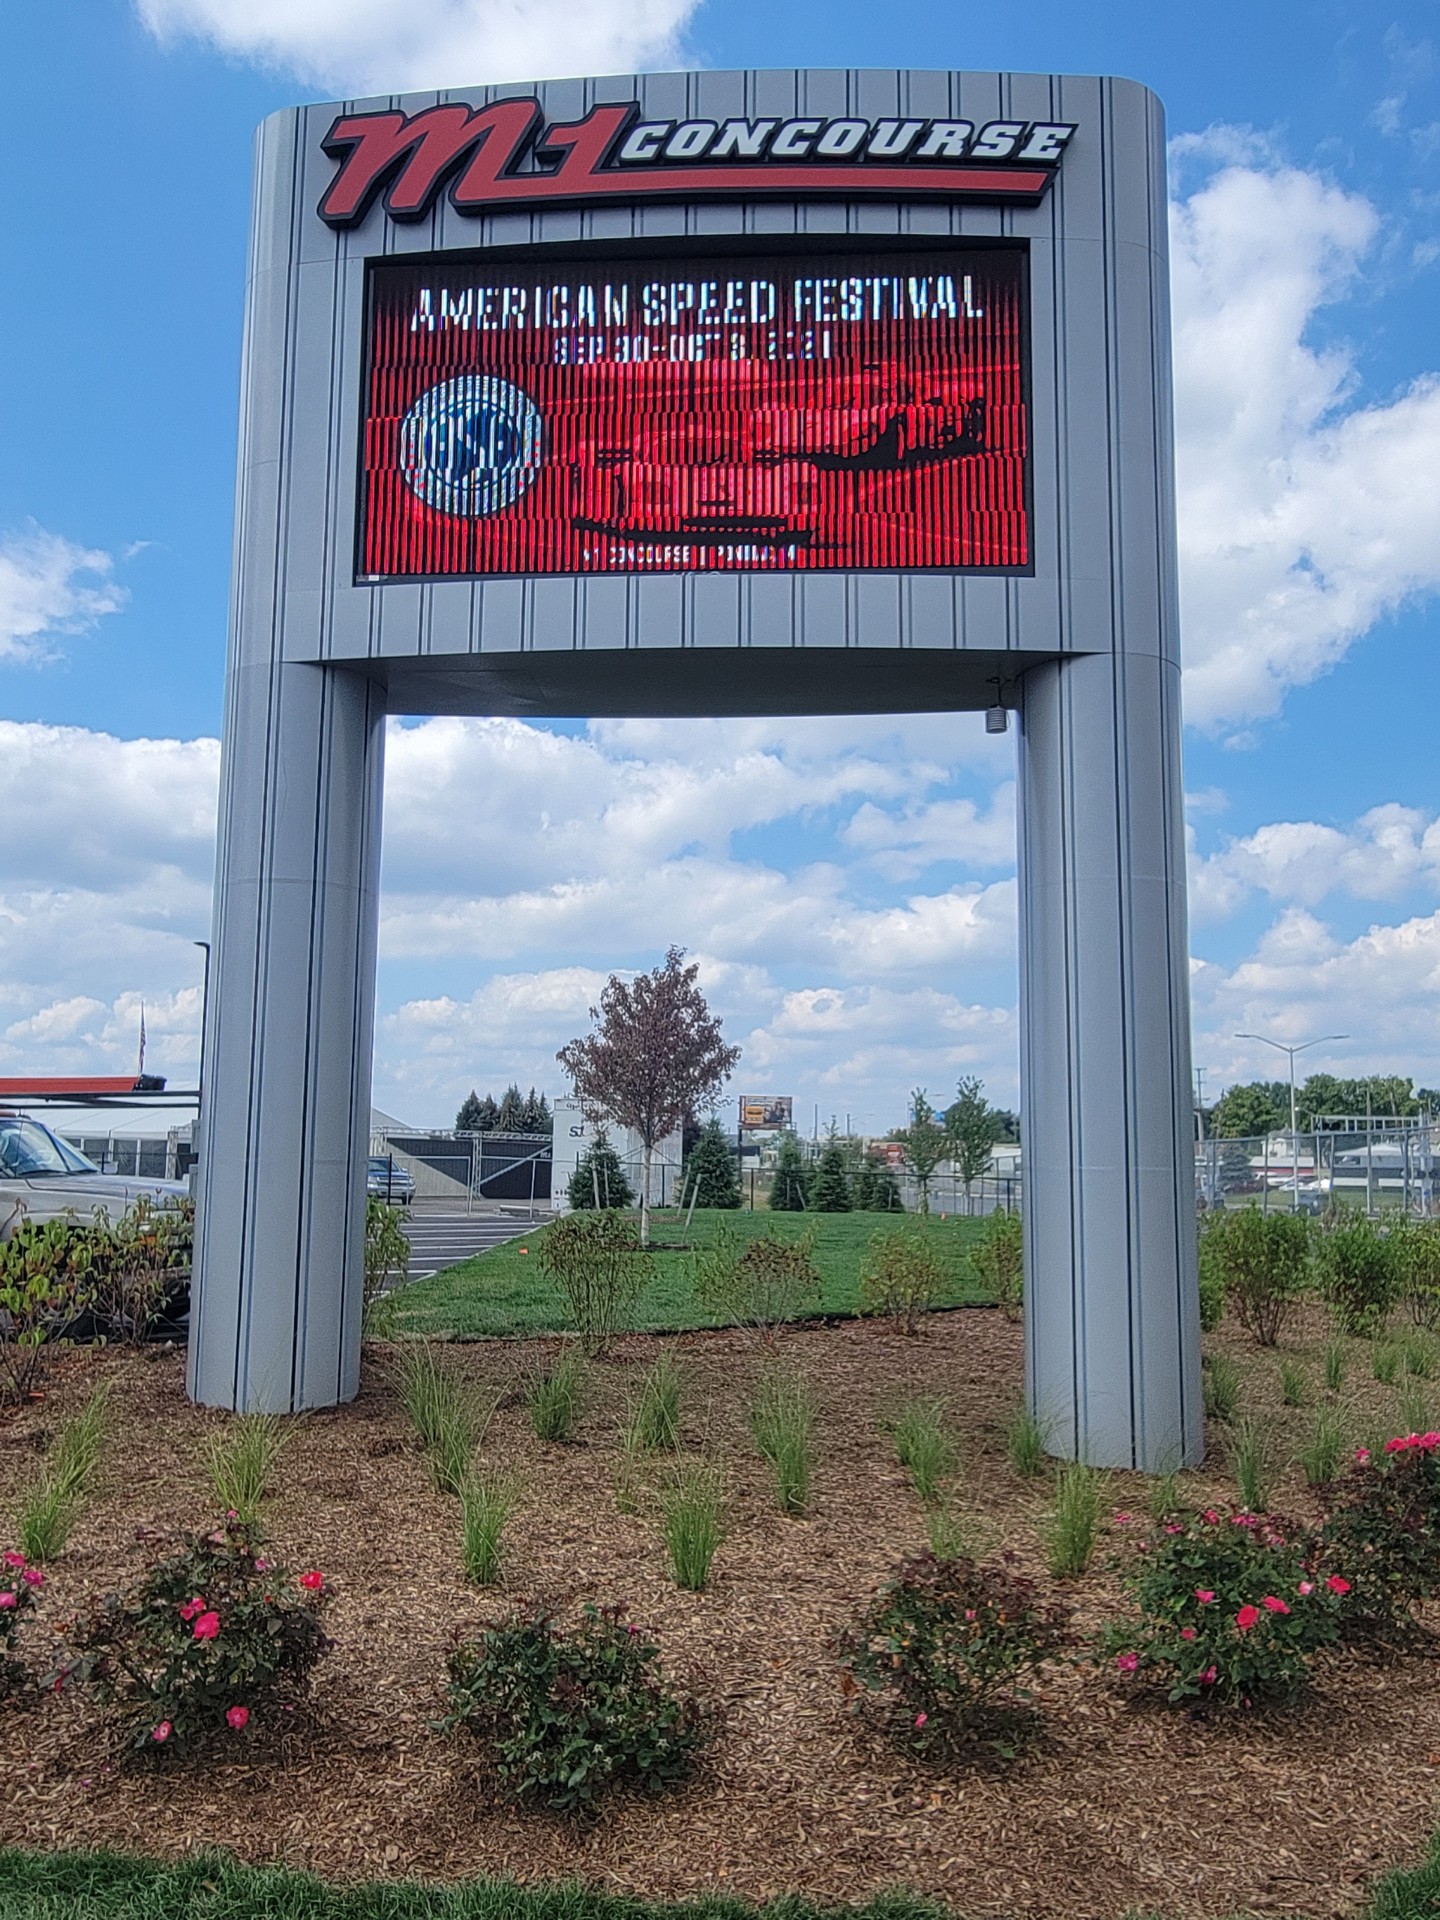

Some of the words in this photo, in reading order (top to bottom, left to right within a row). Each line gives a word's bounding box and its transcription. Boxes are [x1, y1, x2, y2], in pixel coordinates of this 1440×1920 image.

[321, 98, 638, 228] M1
[618, 121, 1077, 163] CONCOURSE
[411, 285, 629, 332] AMERICAN
[643, 280, 776, 327] SPEED
[795, 275, 984, 322] FESTIVAL
